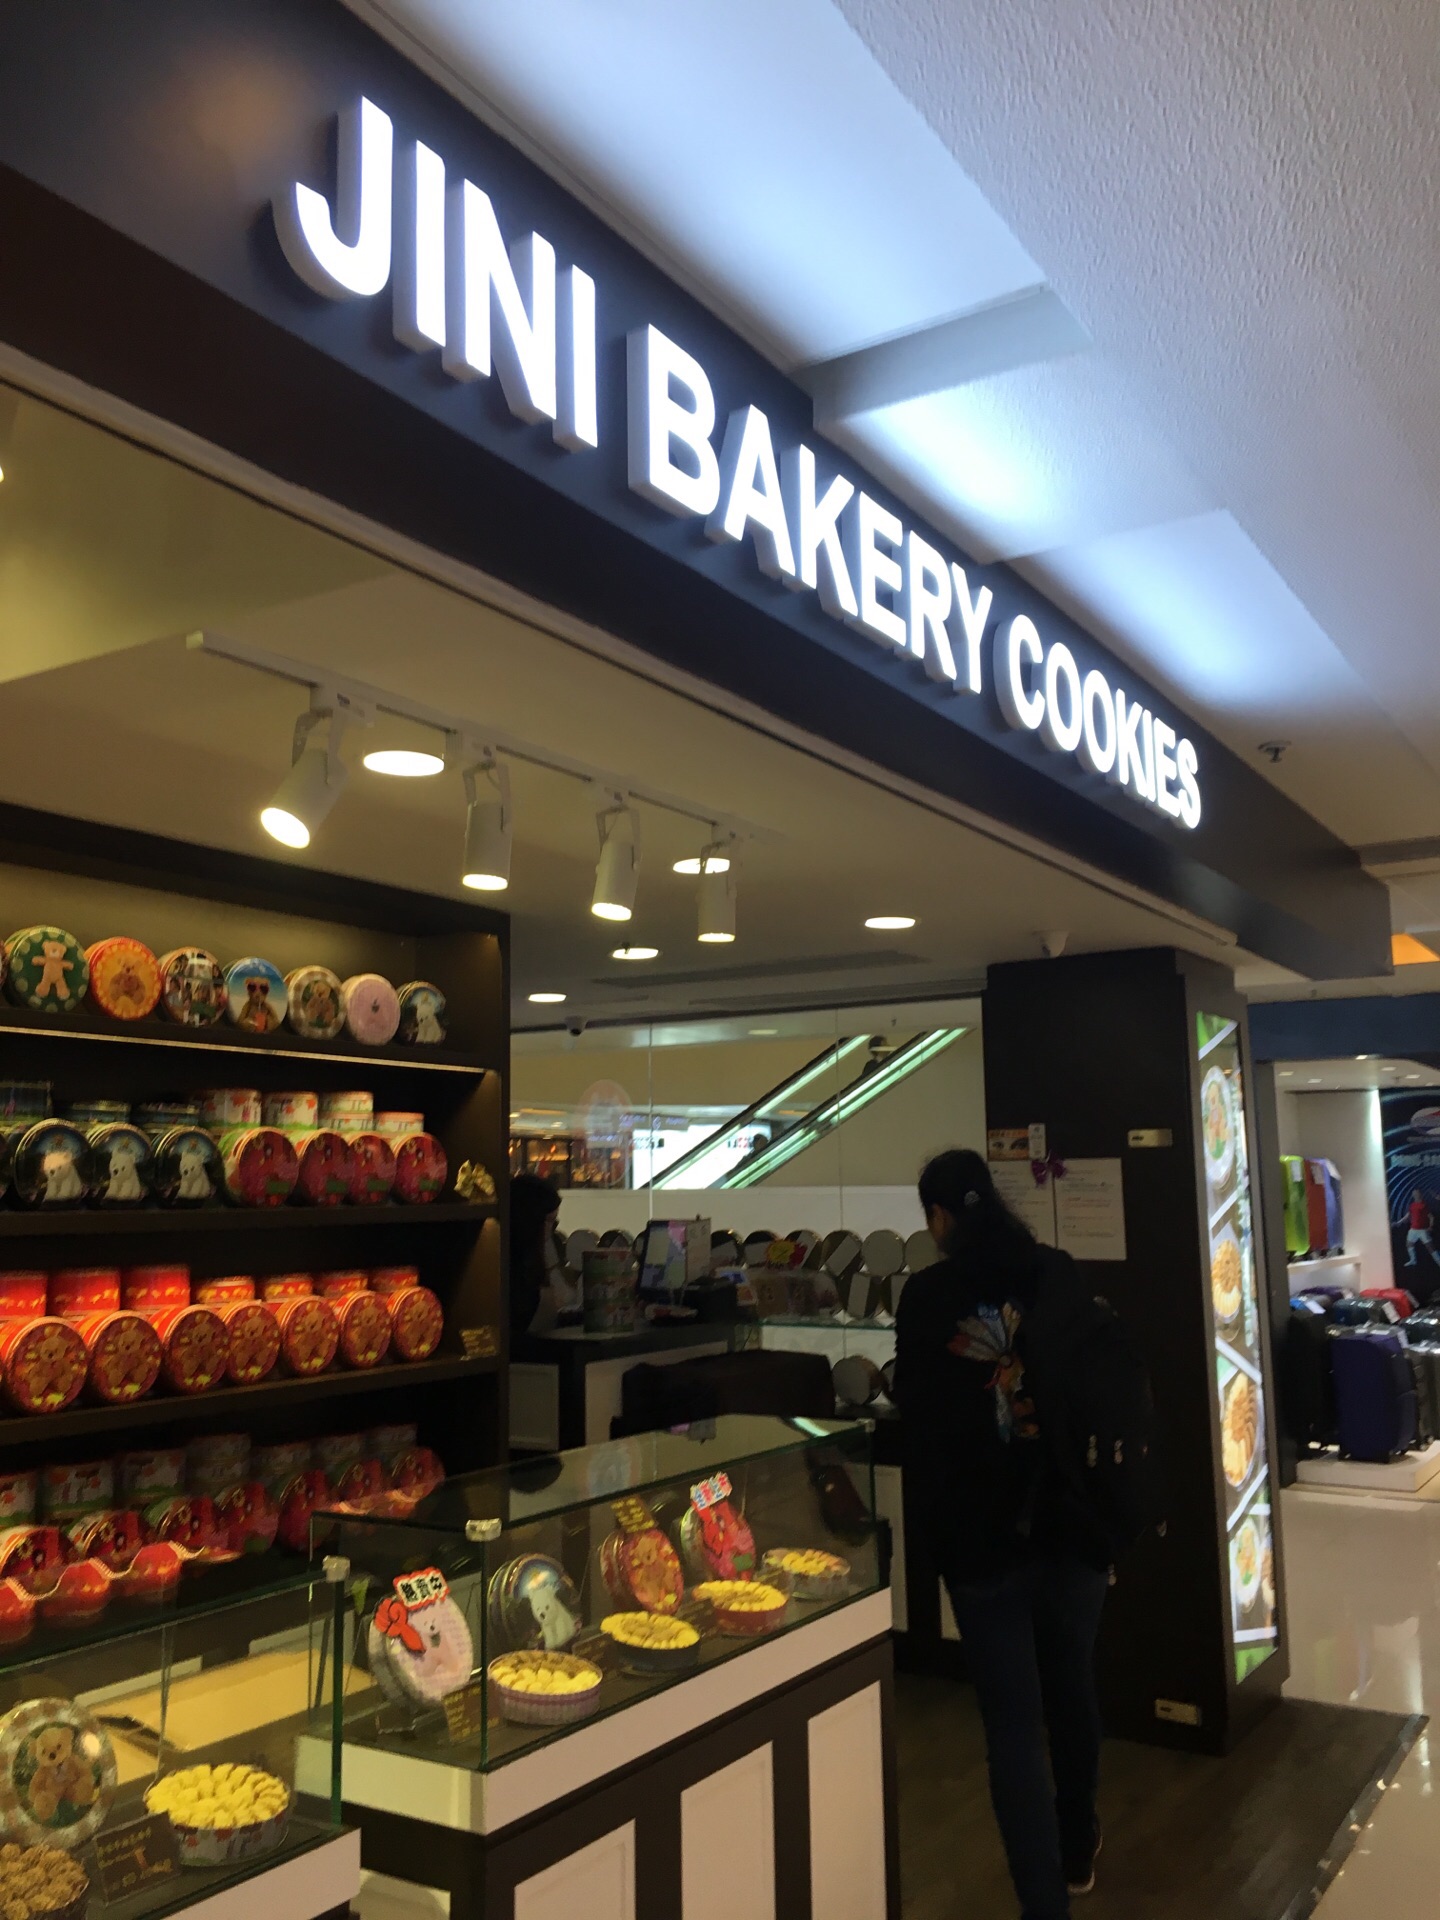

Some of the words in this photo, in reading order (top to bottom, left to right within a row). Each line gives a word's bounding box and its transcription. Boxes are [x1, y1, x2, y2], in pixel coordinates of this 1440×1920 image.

[295, 95, 598, 448] JINI
[648, 323, 993, 695] BAKERY
[1008, 614, 1202, 829] COOKIES
